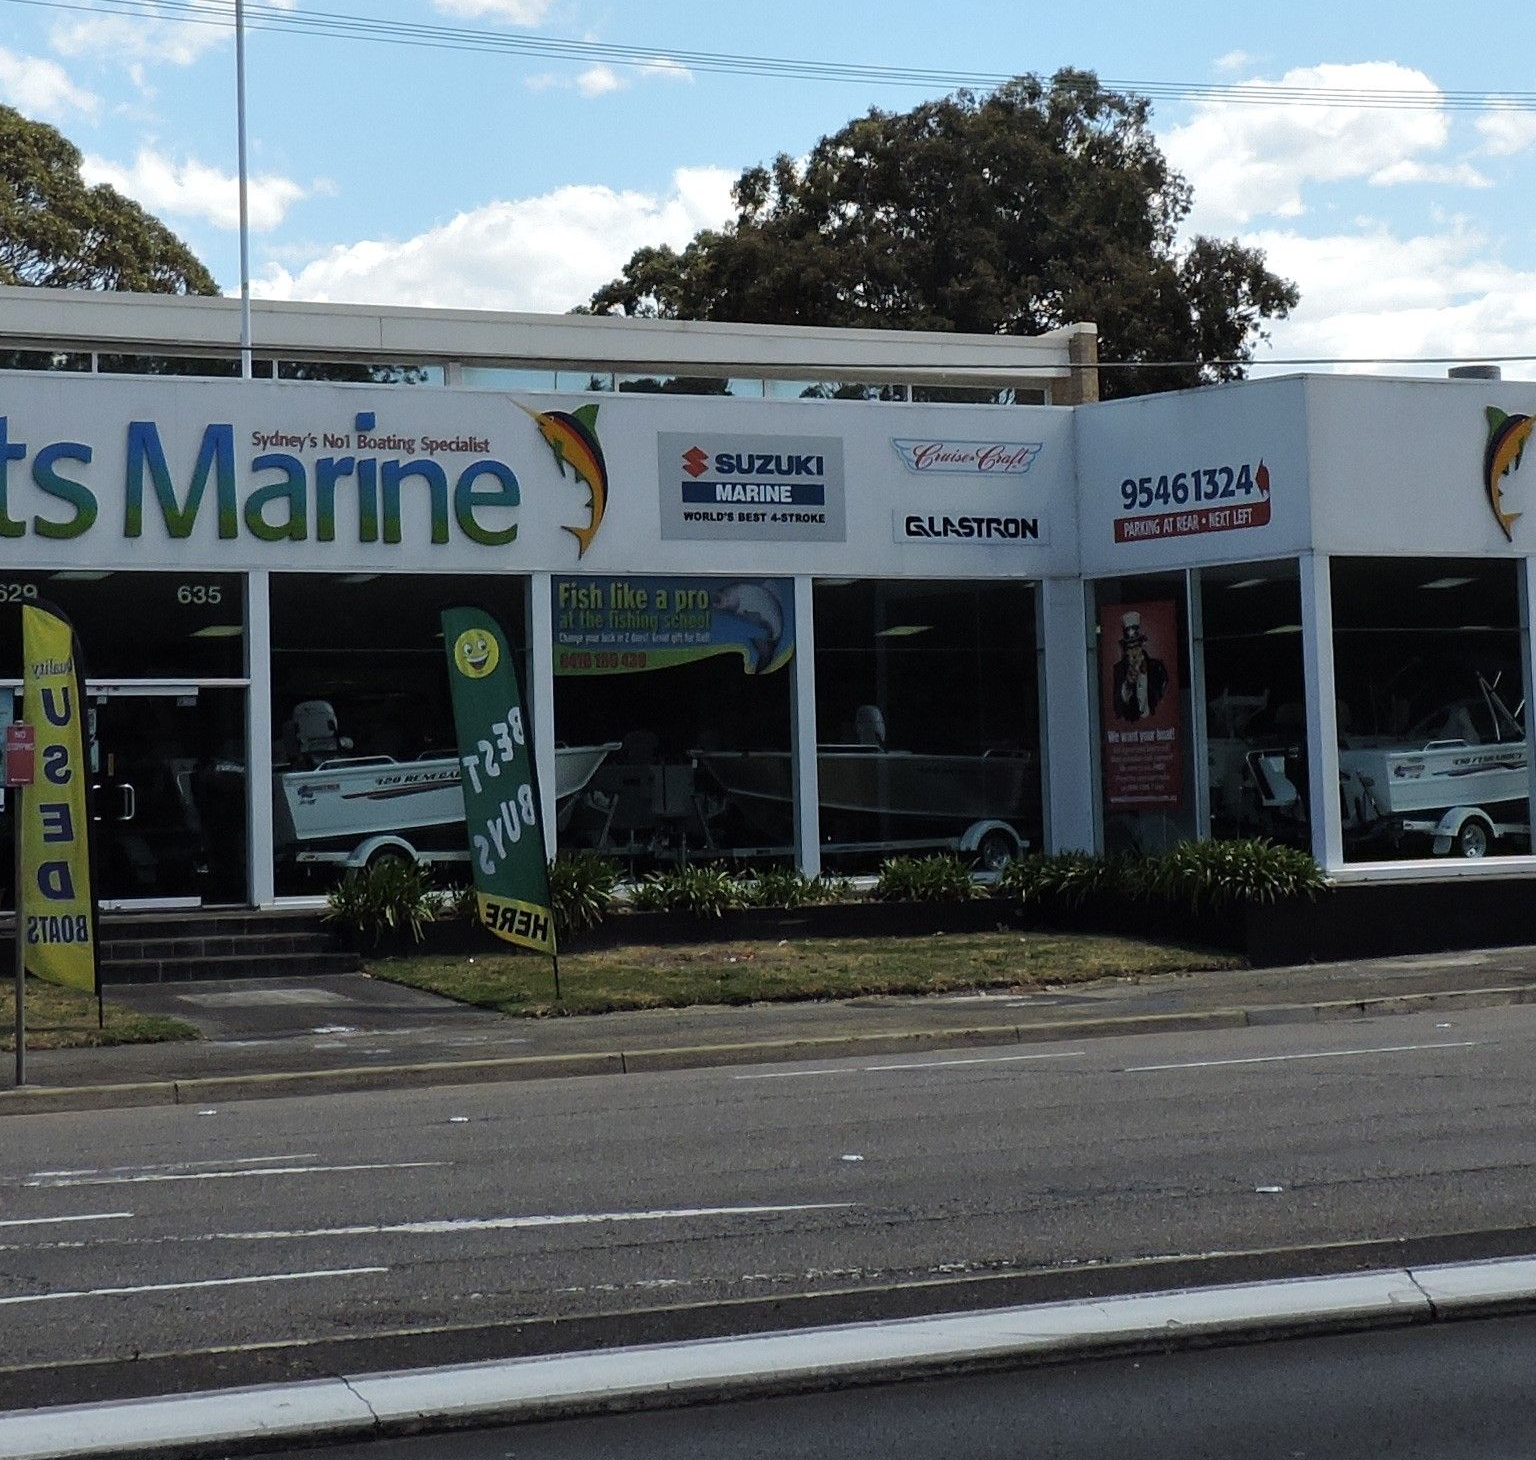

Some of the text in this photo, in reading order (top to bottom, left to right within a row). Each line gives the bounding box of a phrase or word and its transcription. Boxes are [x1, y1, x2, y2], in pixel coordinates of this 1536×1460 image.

[252, 431, 317, 453] Sydney's
[357, 434, 415, 455] Boating
[420, 436, 490, 455] Specialist
[715, 453, 824, 476] SUZUKI
[123, 411, 520, 547] Marine
[716, 484, 793, 502] MARINE
[683, 511, 825, 524] WORLD'S BEST 4-STROKE
[905, 516, 1039, 539] GLASTRON
[1124, 507, 1253, 538] PARKING AT REAR NEXT LEFT
[177, 585, 222, 605] 635
[558, 581, 709, 613] Fish like a pro
[559, 611, 710, 633] at the fishing school
